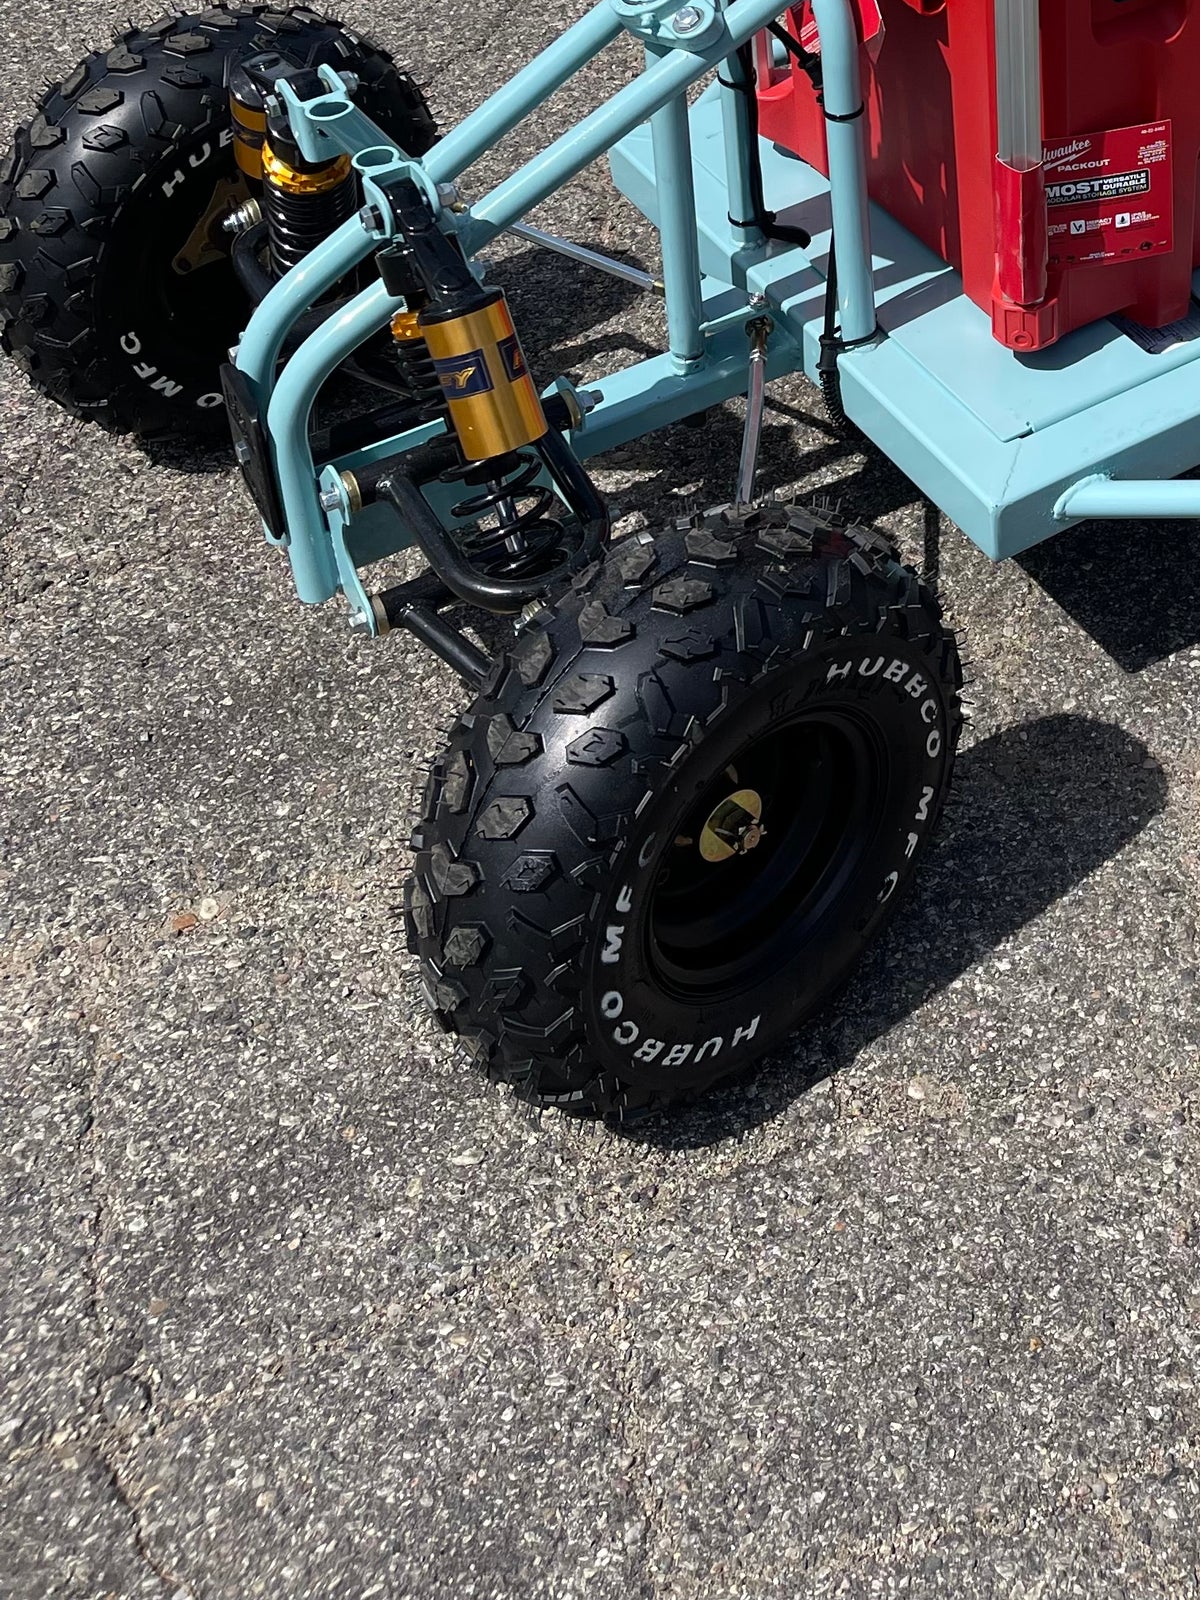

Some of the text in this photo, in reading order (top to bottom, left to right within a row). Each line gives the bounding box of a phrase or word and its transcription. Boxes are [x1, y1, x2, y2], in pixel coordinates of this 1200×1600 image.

[1042, 139, 1092, 162] lwaukee
[1057, 158, 1111, 173] PACKOUT
[1044, 172, 1147, 198] MOST VERSATILE
[1082, 189, 1117, 201] STORAGE
[1118, 184, 1148, 195] SYSTEM
[1102, 178, 1147, 191] DURABLE
